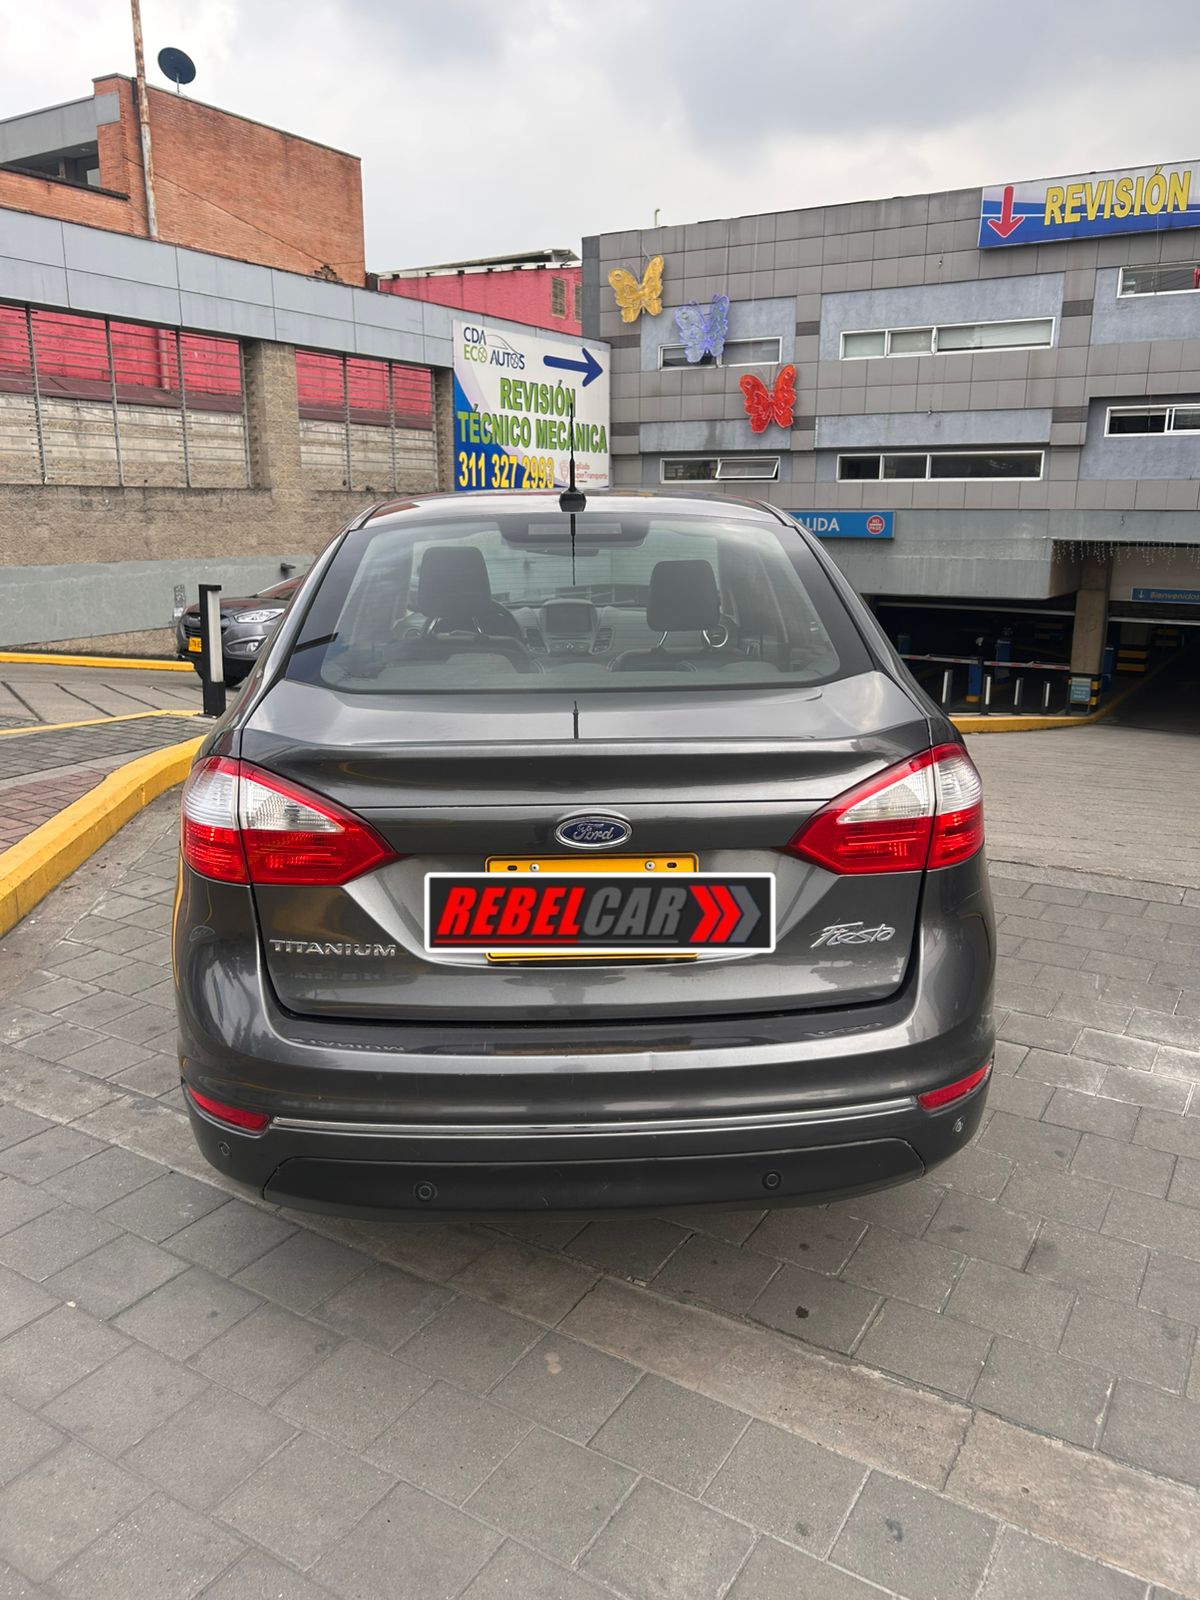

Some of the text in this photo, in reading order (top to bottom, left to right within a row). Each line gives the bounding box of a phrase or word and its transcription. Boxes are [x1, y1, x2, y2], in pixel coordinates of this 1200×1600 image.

[1044, 164, 1191, 226] REVISIÓN
[464, 326, 487, 346] CDA
[464, 343, 525, 370] ECO AUTOS
[500, 377, 576, 418] REVISIÓN
[457, 404, 532, 449] TÉCNICO
[458, 451, 555, 490] 311 327 2993
[572, 822, 615, 840] Ford
[269, 938, 397, 957] TITANIUM
[810, 921, 896, 949] Fiesta
